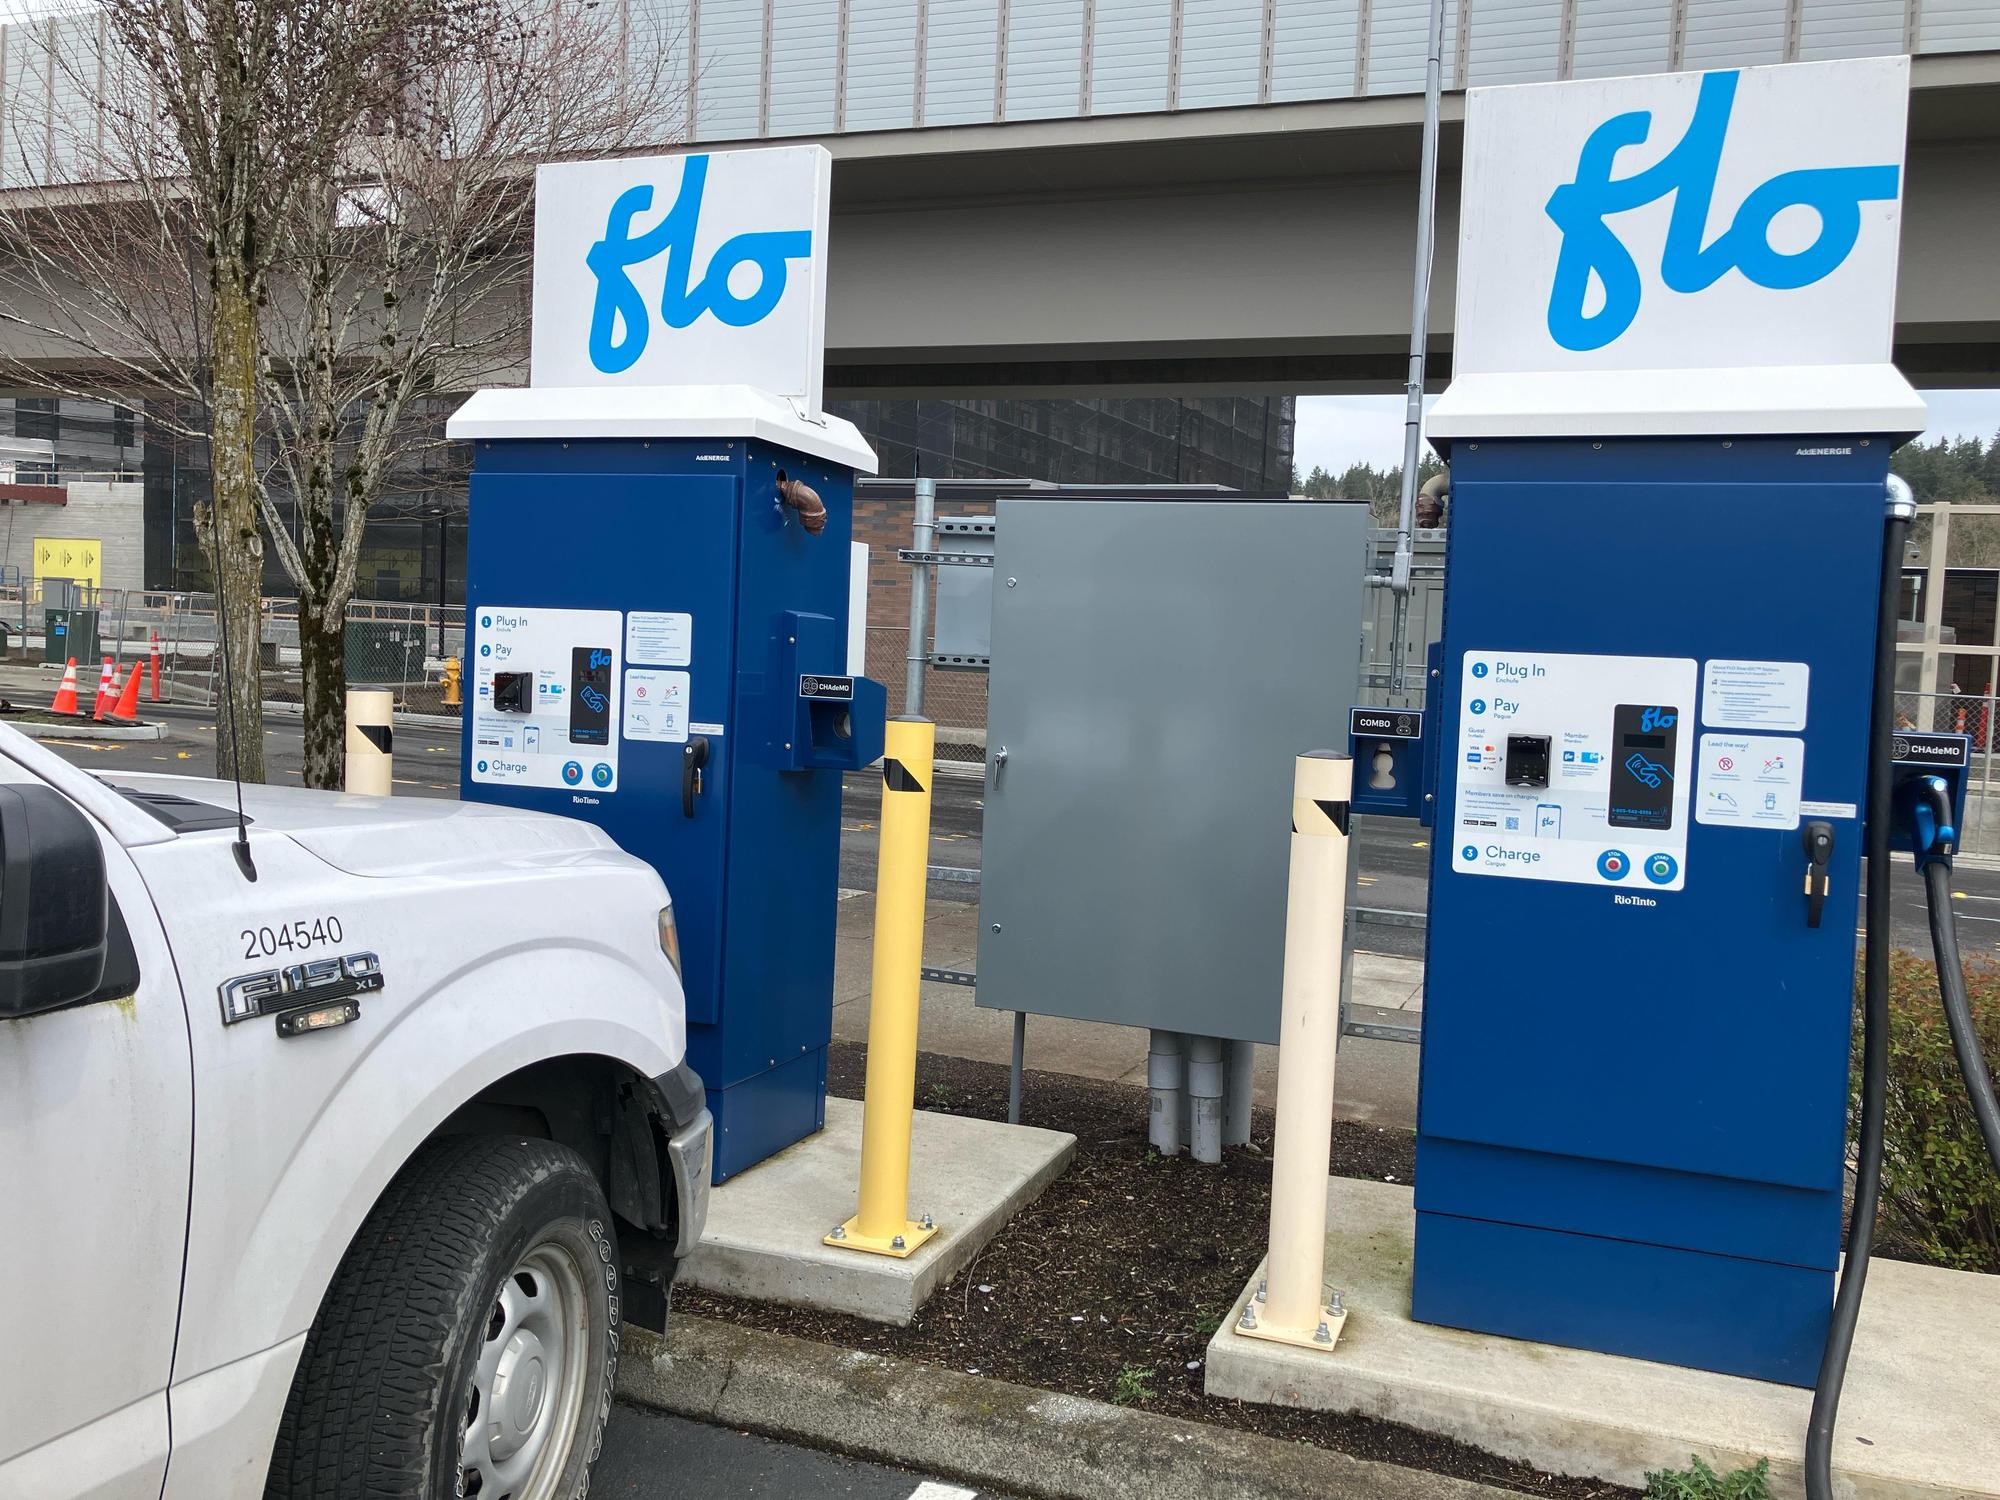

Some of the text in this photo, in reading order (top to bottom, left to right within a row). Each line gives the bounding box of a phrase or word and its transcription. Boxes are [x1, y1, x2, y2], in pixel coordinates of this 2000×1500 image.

[1545, 69, 1900, 352] flo
[586, 154, 812, 374] flo
[1796, 447, 1852, 456] AddENERGIE
[496, 615, 517, 628] Plug
[519, 615, 528, 626] In
[495, 643, 512, 656] Pay
[590, 648, 612, 669] flo
[1496, 662, 1528, 679] Plug
[1532, 663, 1546, 677] In
[819, 683, 850, 692] CHAdeMO
[1494, 697, 1520, 714] Pay
[1360, 718, 1391, 728] COMBO
[1641, 705, 1679, 733] flo
[1911, 745, 1960, 756] CHAdeMO
[492, 759, 528, 774] Charge
[1486, 845, 1541, 864] Charge
[240, 915, 343, 960] 204540
[355, 979, 378, 991] XL
